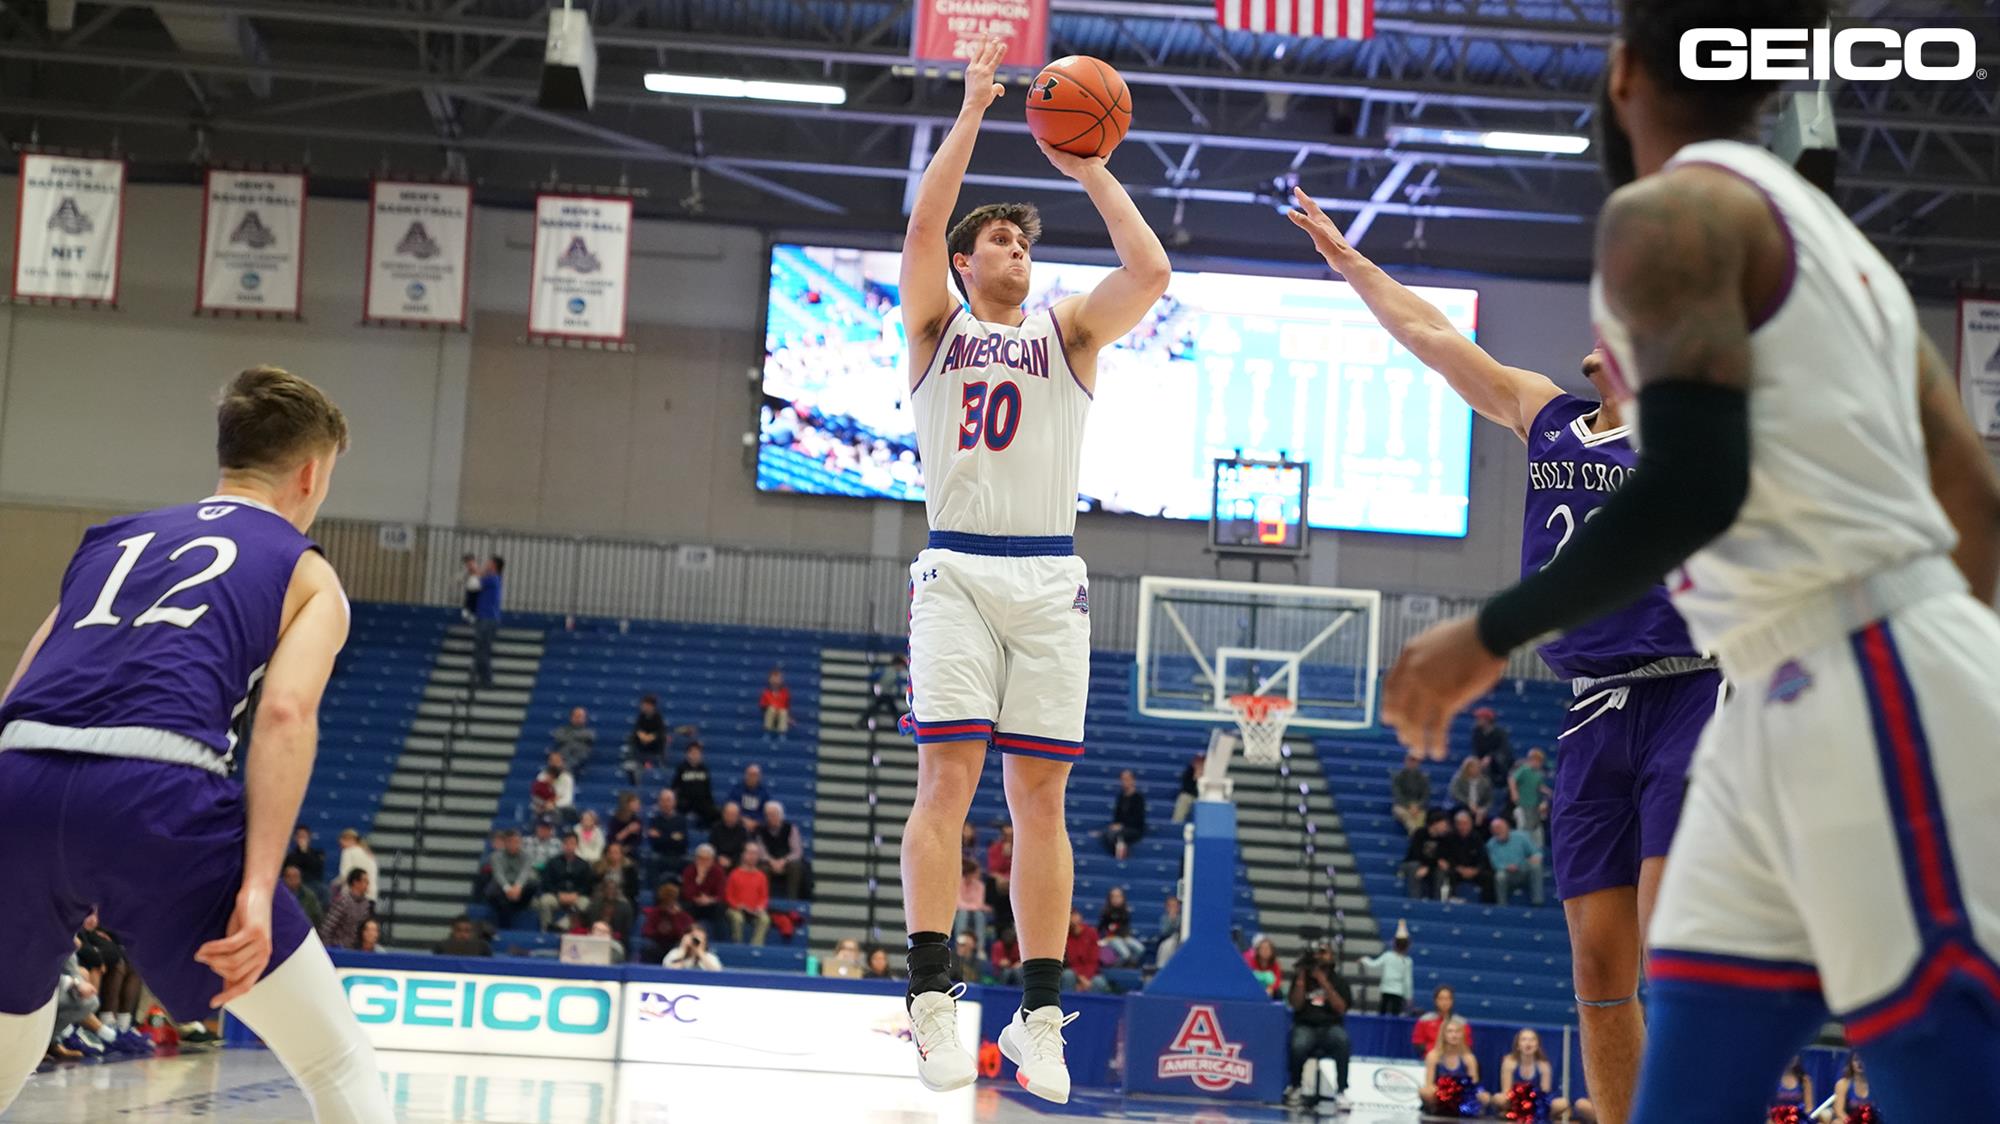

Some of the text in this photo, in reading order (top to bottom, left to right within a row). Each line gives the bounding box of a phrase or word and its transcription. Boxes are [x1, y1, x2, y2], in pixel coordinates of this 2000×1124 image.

[935, 1, 1030, 20] CHAMPION
[51, 246, 86, 260] NIT
[940, 332, 1050, 379] AMERICAN
[958, 380, 1022, 451] 30
[1530, 461, 1636, 492] HOLY CRO
[73, 531, 238, 629] 12
[342, 974, 611, 1035] GEICO
[1163, 1057, 1246, 1077] AMERICAN
